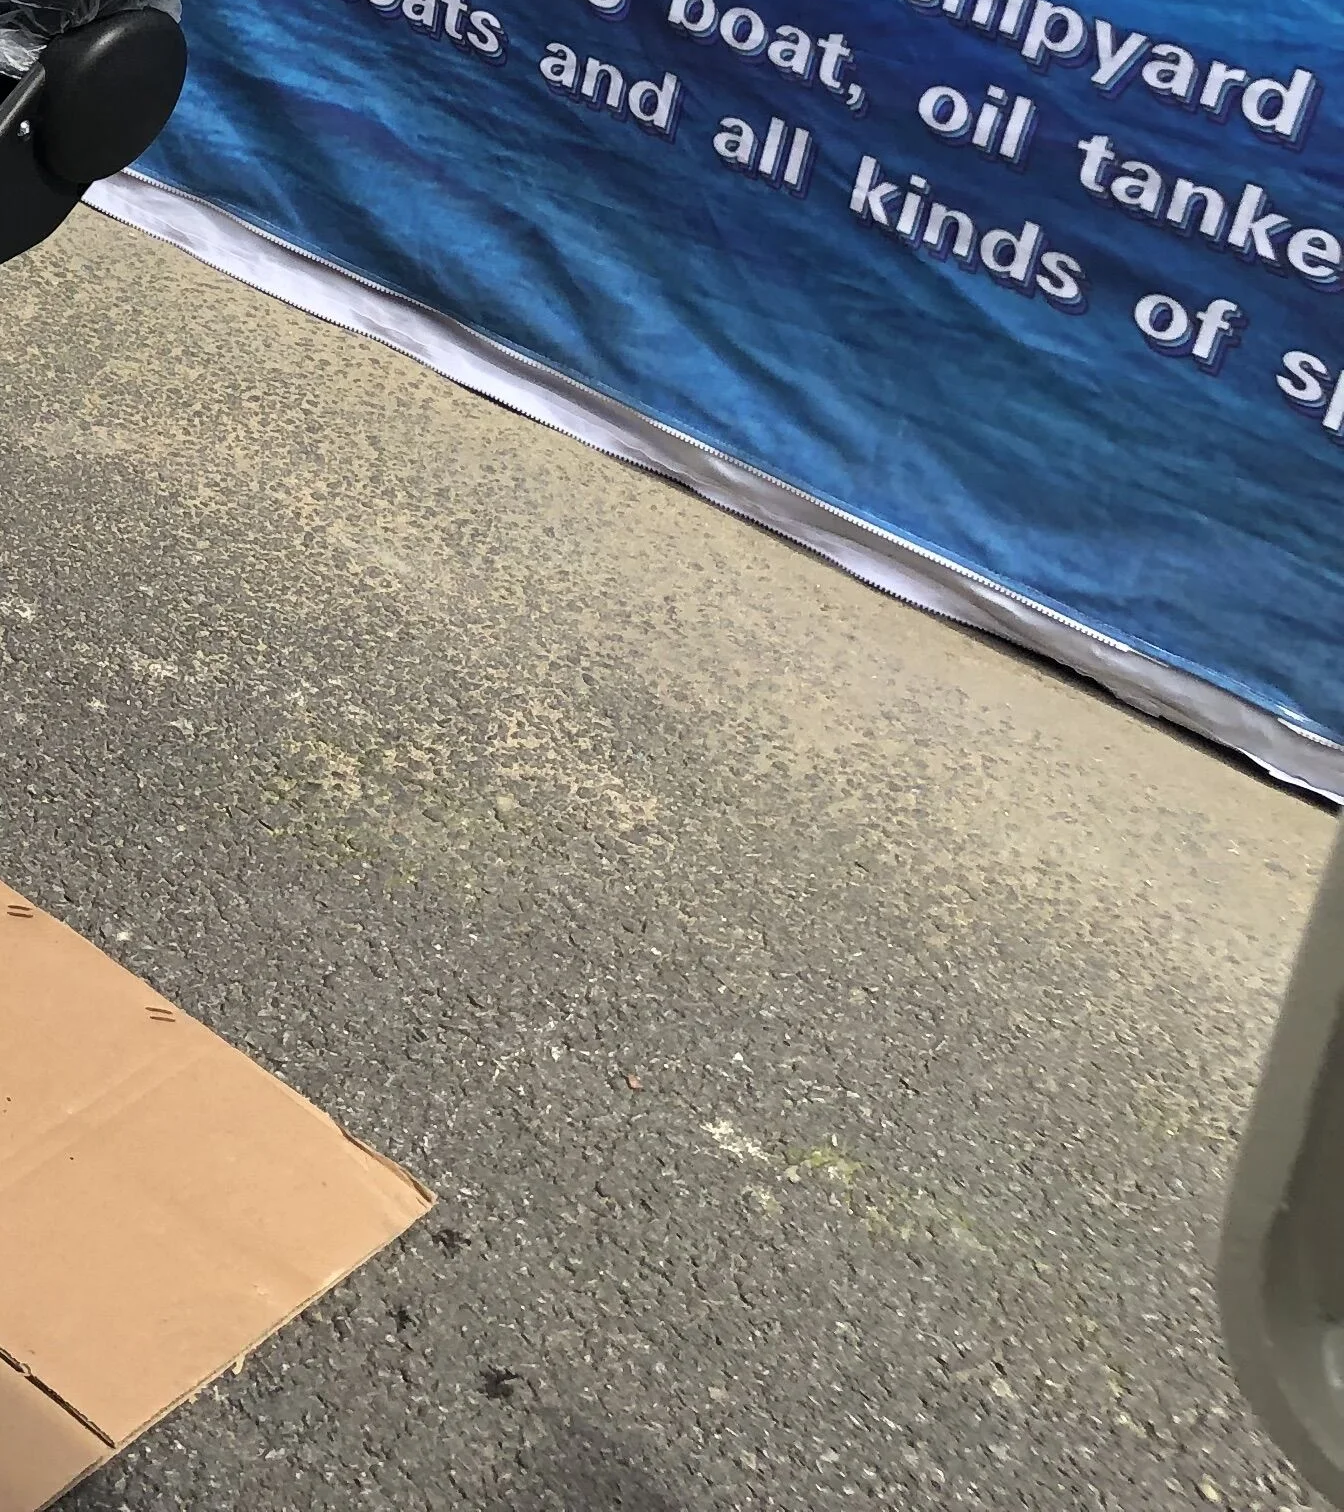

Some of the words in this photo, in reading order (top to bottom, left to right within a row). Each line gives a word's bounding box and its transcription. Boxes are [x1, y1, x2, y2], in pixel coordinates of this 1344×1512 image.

[540, 42, 677, 128] and
[713, 116, 809, 185] all
[849, 154, 1080, 299] kinds
[1133, 293, 1238, 359] of
[917, 85, 1032, 158] oil
[1077, 135, 1343, 278] tanke
